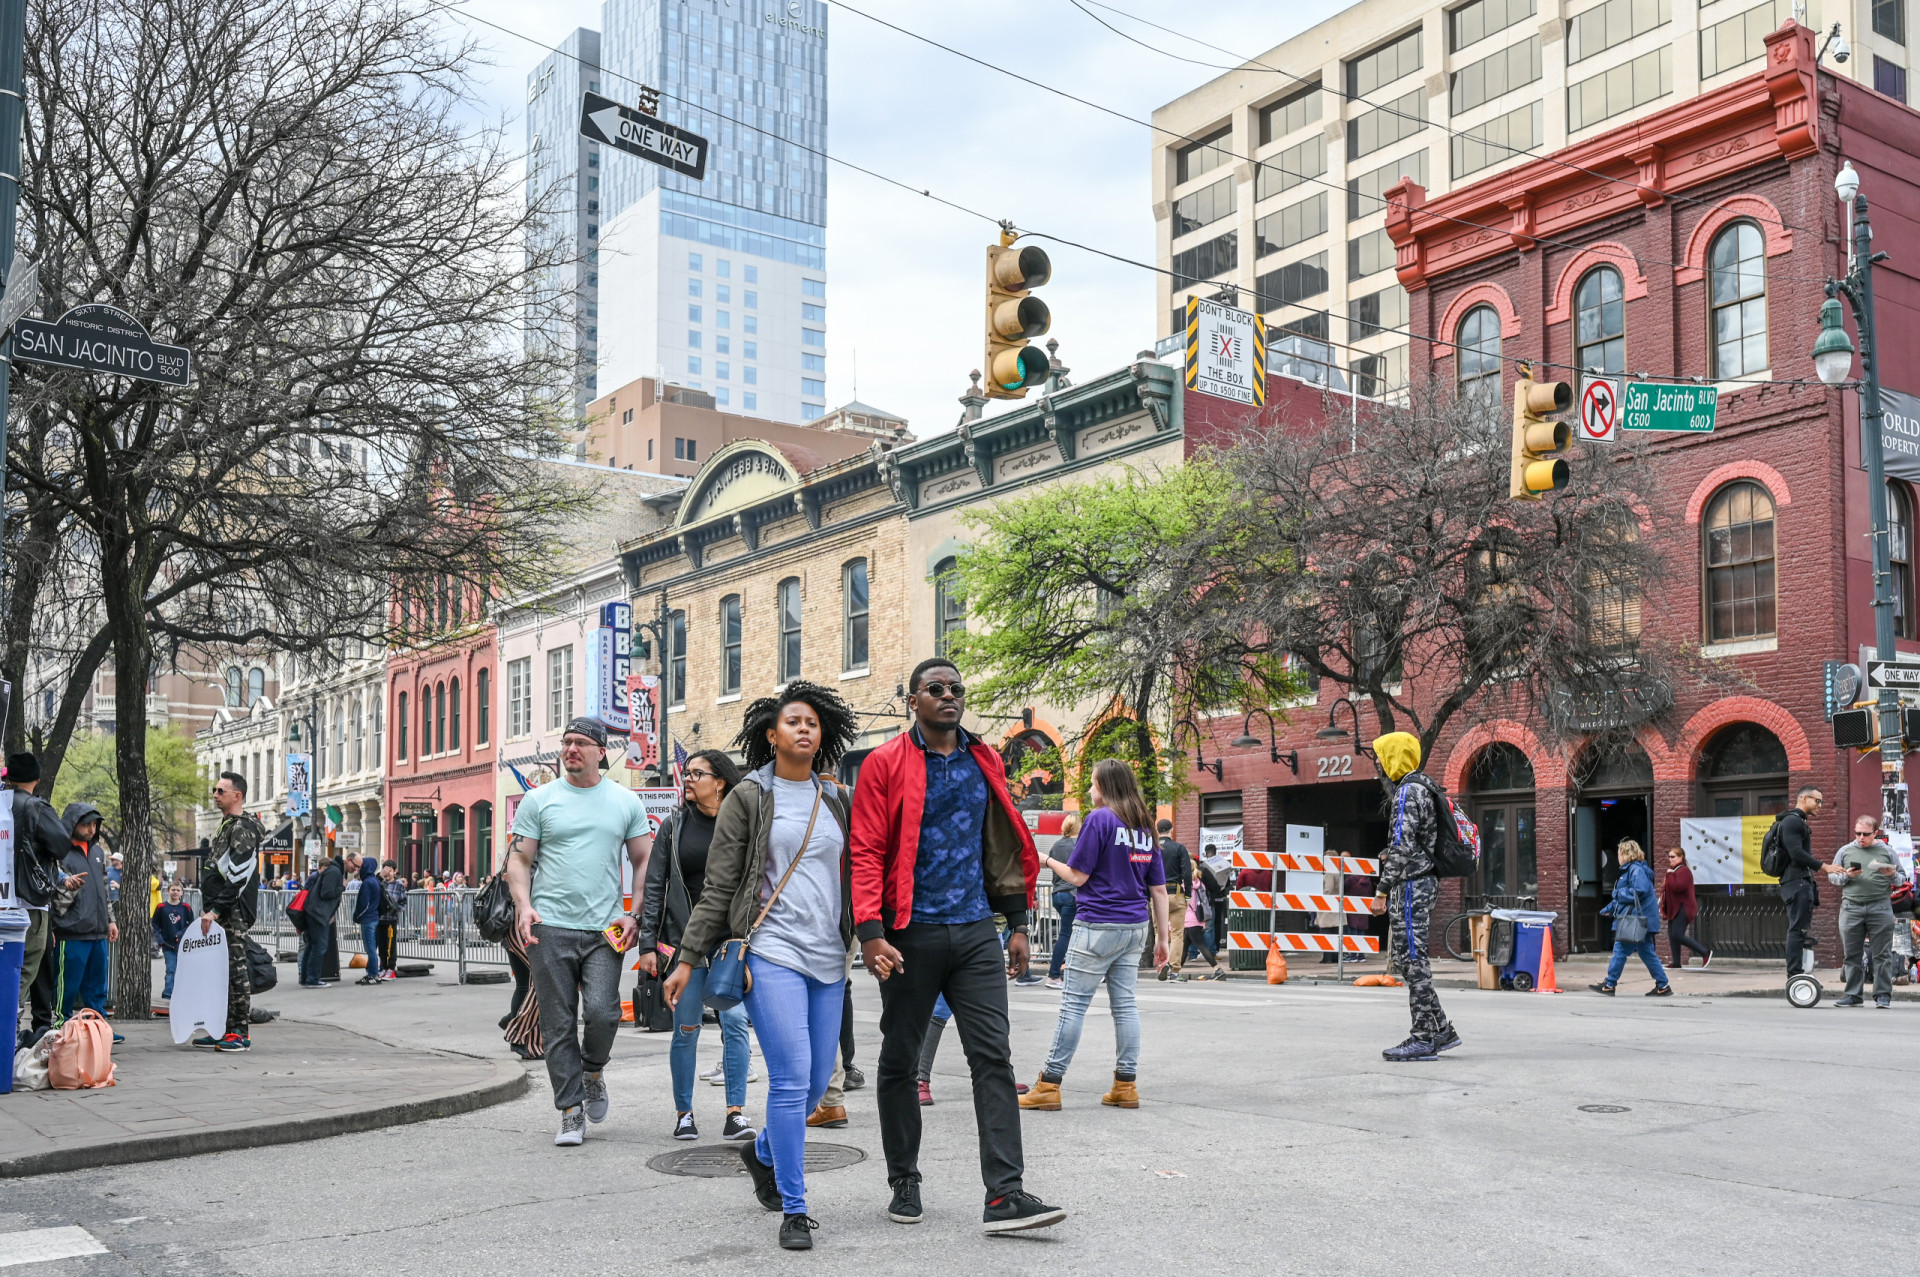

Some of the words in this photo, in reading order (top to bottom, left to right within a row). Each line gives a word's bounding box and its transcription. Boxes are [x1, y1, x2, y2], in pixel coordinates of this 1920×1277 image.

[765, 13, 825, 39] element
[619, 120, 654, 148] ONE
[659, 135, 695, 162] WAY
[8, 268, 36, 313] STREET
[103, 307, 136, 327] STREET
[1225, 310, 1252, 327] BLOCK
[65, 318, 104, 331] HISTORIC
[107, 326, 144, 339] DISTRICT
[20, 329, 64, 356] SAN
[68, 338, 154, 371] JACINTO
[157, 354, 184, 367] BLVD
[160, 366, 181, 377] 500
[1207, 366, 1223, 380] THE
[1227, 371, 1243, 385] BOX
[1199, 380, 1207, 389] UP
[1210, 382, 1218, 392] TO
[1220, 385, 1236, 397] $500
[1238, 390, 1251, 401] FINE
[1627, 386, 1649, 410] San
[1653, 388, 1694, 412] Jacinto
[1698, 390, 1716, 405] BLVD
[1634, 413, 1650, 427] 500
[1690, 415, 1705, 428] 600
[1881, 411, 1920, 437] ORLD
[1881, 434, 1920, 456] OPERTY
[724, 457, 753, 483] WEBB
[755, 457, 763, 472] &
[764, 459, 786, 481] BRO.
[1884, 669, 1901, 680] ONE
[1902, 670, 1920, 680] WAY
[630, 691, 649, 706] SX
[608, 714, 630, 725] SPOR
[631, 706, 652, 721] SW
[289, 764, 303, 774] SX
[1317, 755, 1353, 778] 222
[290, 774, 306, 784] SW
[0, 829, 9, 840] ON
[182, 933, 222, 953] @jcreek813
